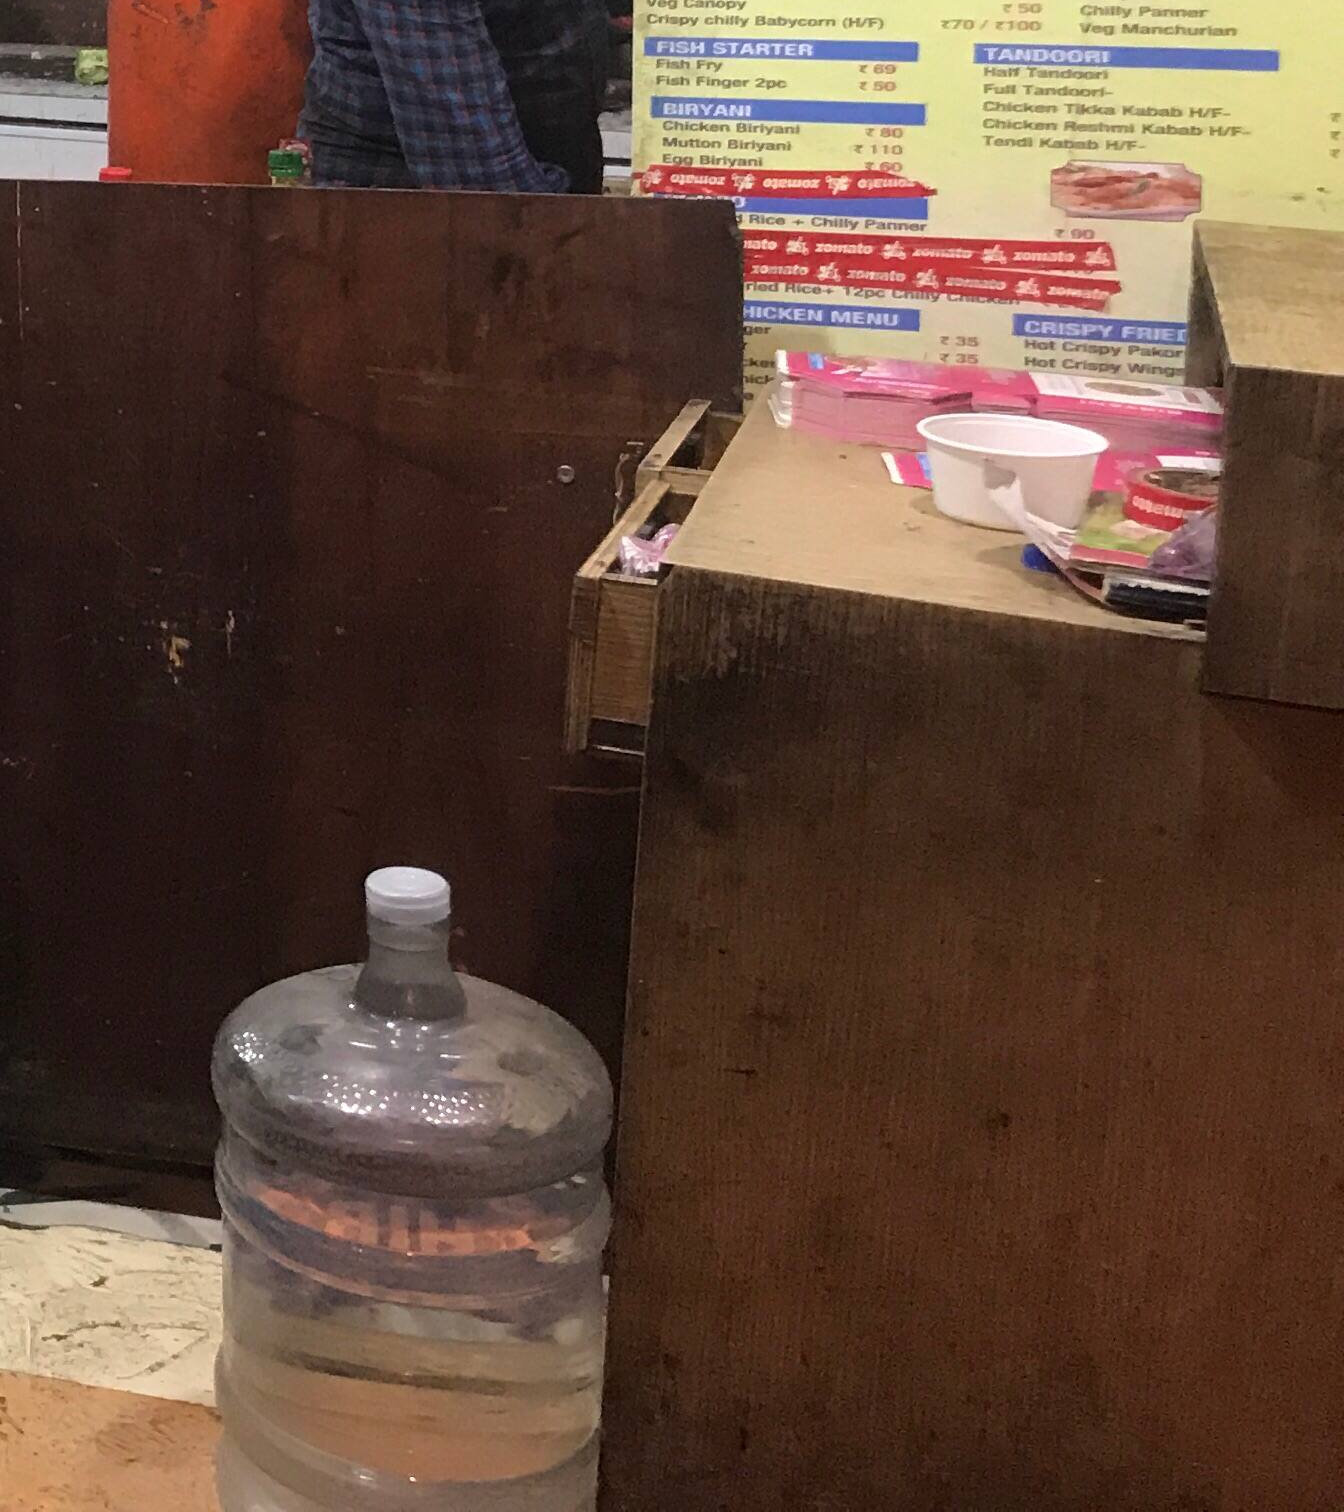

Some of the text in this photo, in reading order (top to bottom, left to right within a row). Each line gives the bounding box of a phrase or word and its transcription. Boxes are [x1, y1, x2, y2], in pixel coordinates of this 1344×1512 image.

[1080, 5, 1208, 19] Chilly Panner
[646, 14, 699, 27] Crispy
[704, 15, 749, 27] chilly
[755, 16, 835, 29] Babycorn
[1079, 23, 1237, 37] Veg Manchurian
[656, 41, 813, 57] FISH STARTER
[983, 48, 1111, 64] TANDOORI
[656, 60, 723, 73] Fish Fry
[983, 67, 1109, 80] Half Tandoori
[656, 76, 786, 91] Fish Finger 2pc
[662, 103, 752, 117] BIRYANI
[983, 101, 1057, 113] Chicken
[1064, 103, 1115, 116] Tikka
[1122, 105, 1183, 118] Kabab
[662, 121, 801, 136] Chicken Biriyani
[662, 138, 791, 152] Mutton Biriyani
[670, 174, 820, 189] zomato zomato
[748, 214, 927, 234] Rice Chilly Panner
[815, 240, 873, 257] zomato
[1013, 249, 1075, 266] zomato
[752, 264, 809, 280] zomato
[846, 269, 907, 286] zomato
[743, 304, 900, 328] HICKEN MENU
[1023, 319, 1113, 341] CRISPY
[1024, 338, 1184, 359] Hot Crispy Pakor
